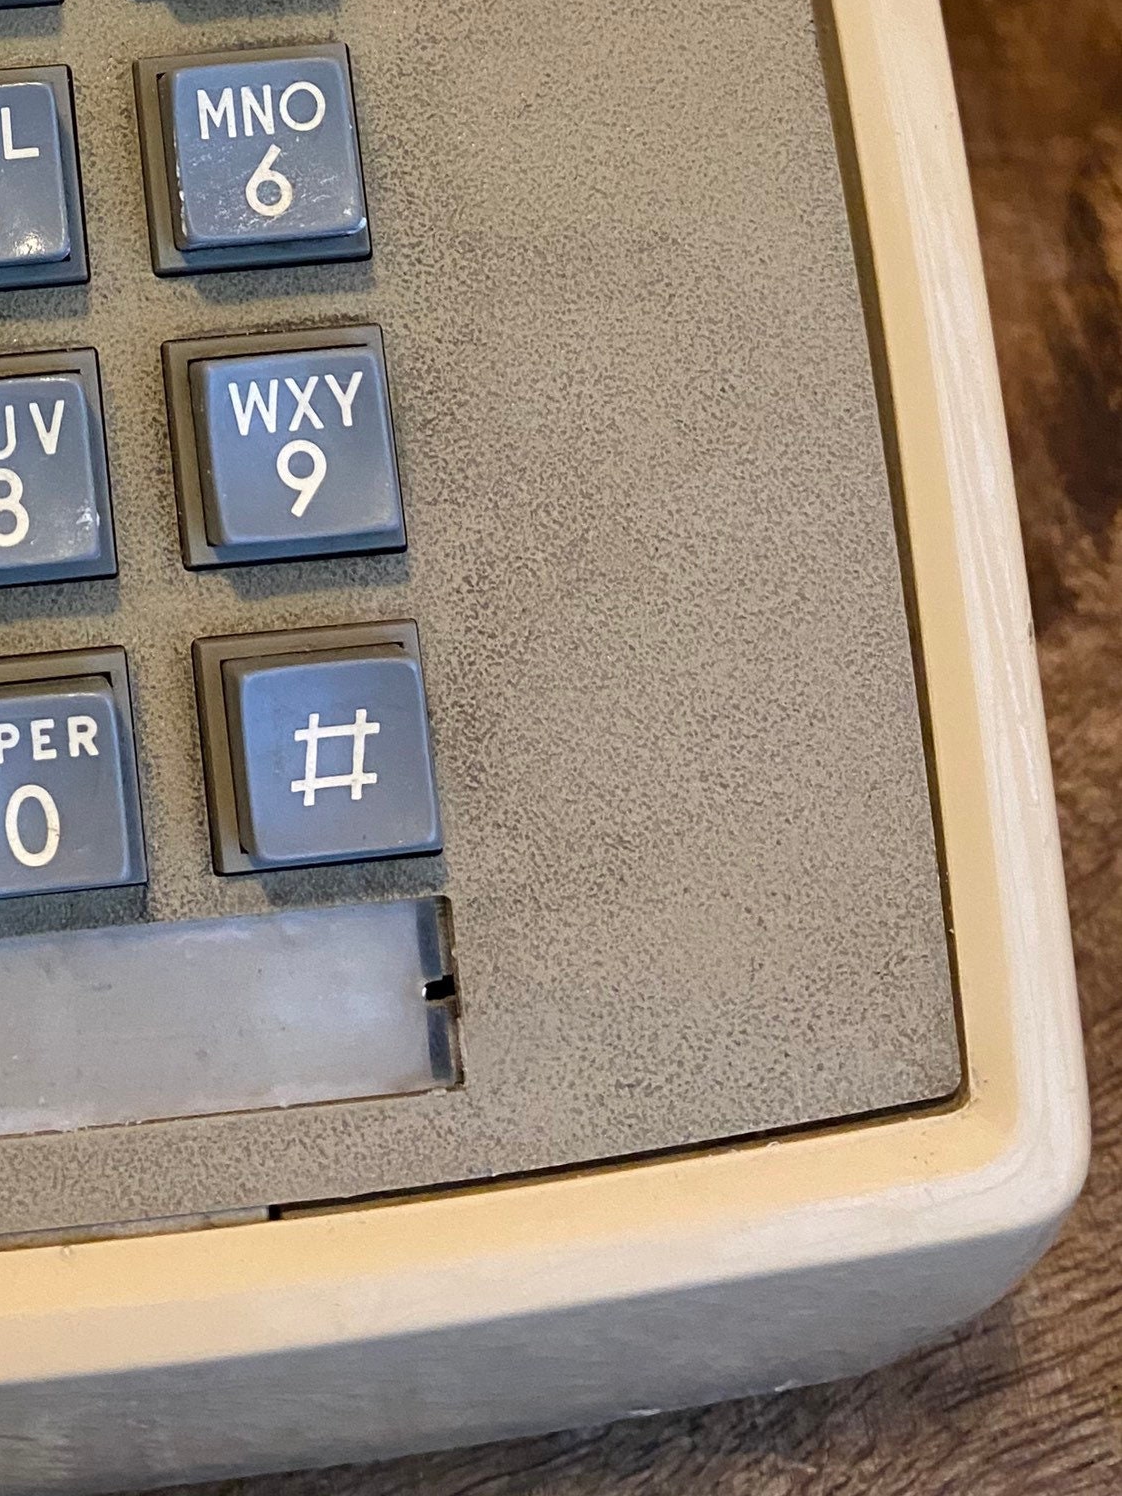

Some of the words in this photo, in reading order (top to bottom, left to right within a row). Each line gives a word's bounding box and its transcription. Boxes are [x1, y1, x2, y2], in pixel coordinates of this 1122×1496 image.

[196, 81, 327, 140] MNO
[245, 143, 296, 220] 6
[228, 370, 364, 437] WXY
[276, 439, 328, 518] 9
[290, 708, 381, 807] #
[4, 784, 61, 867] 0
